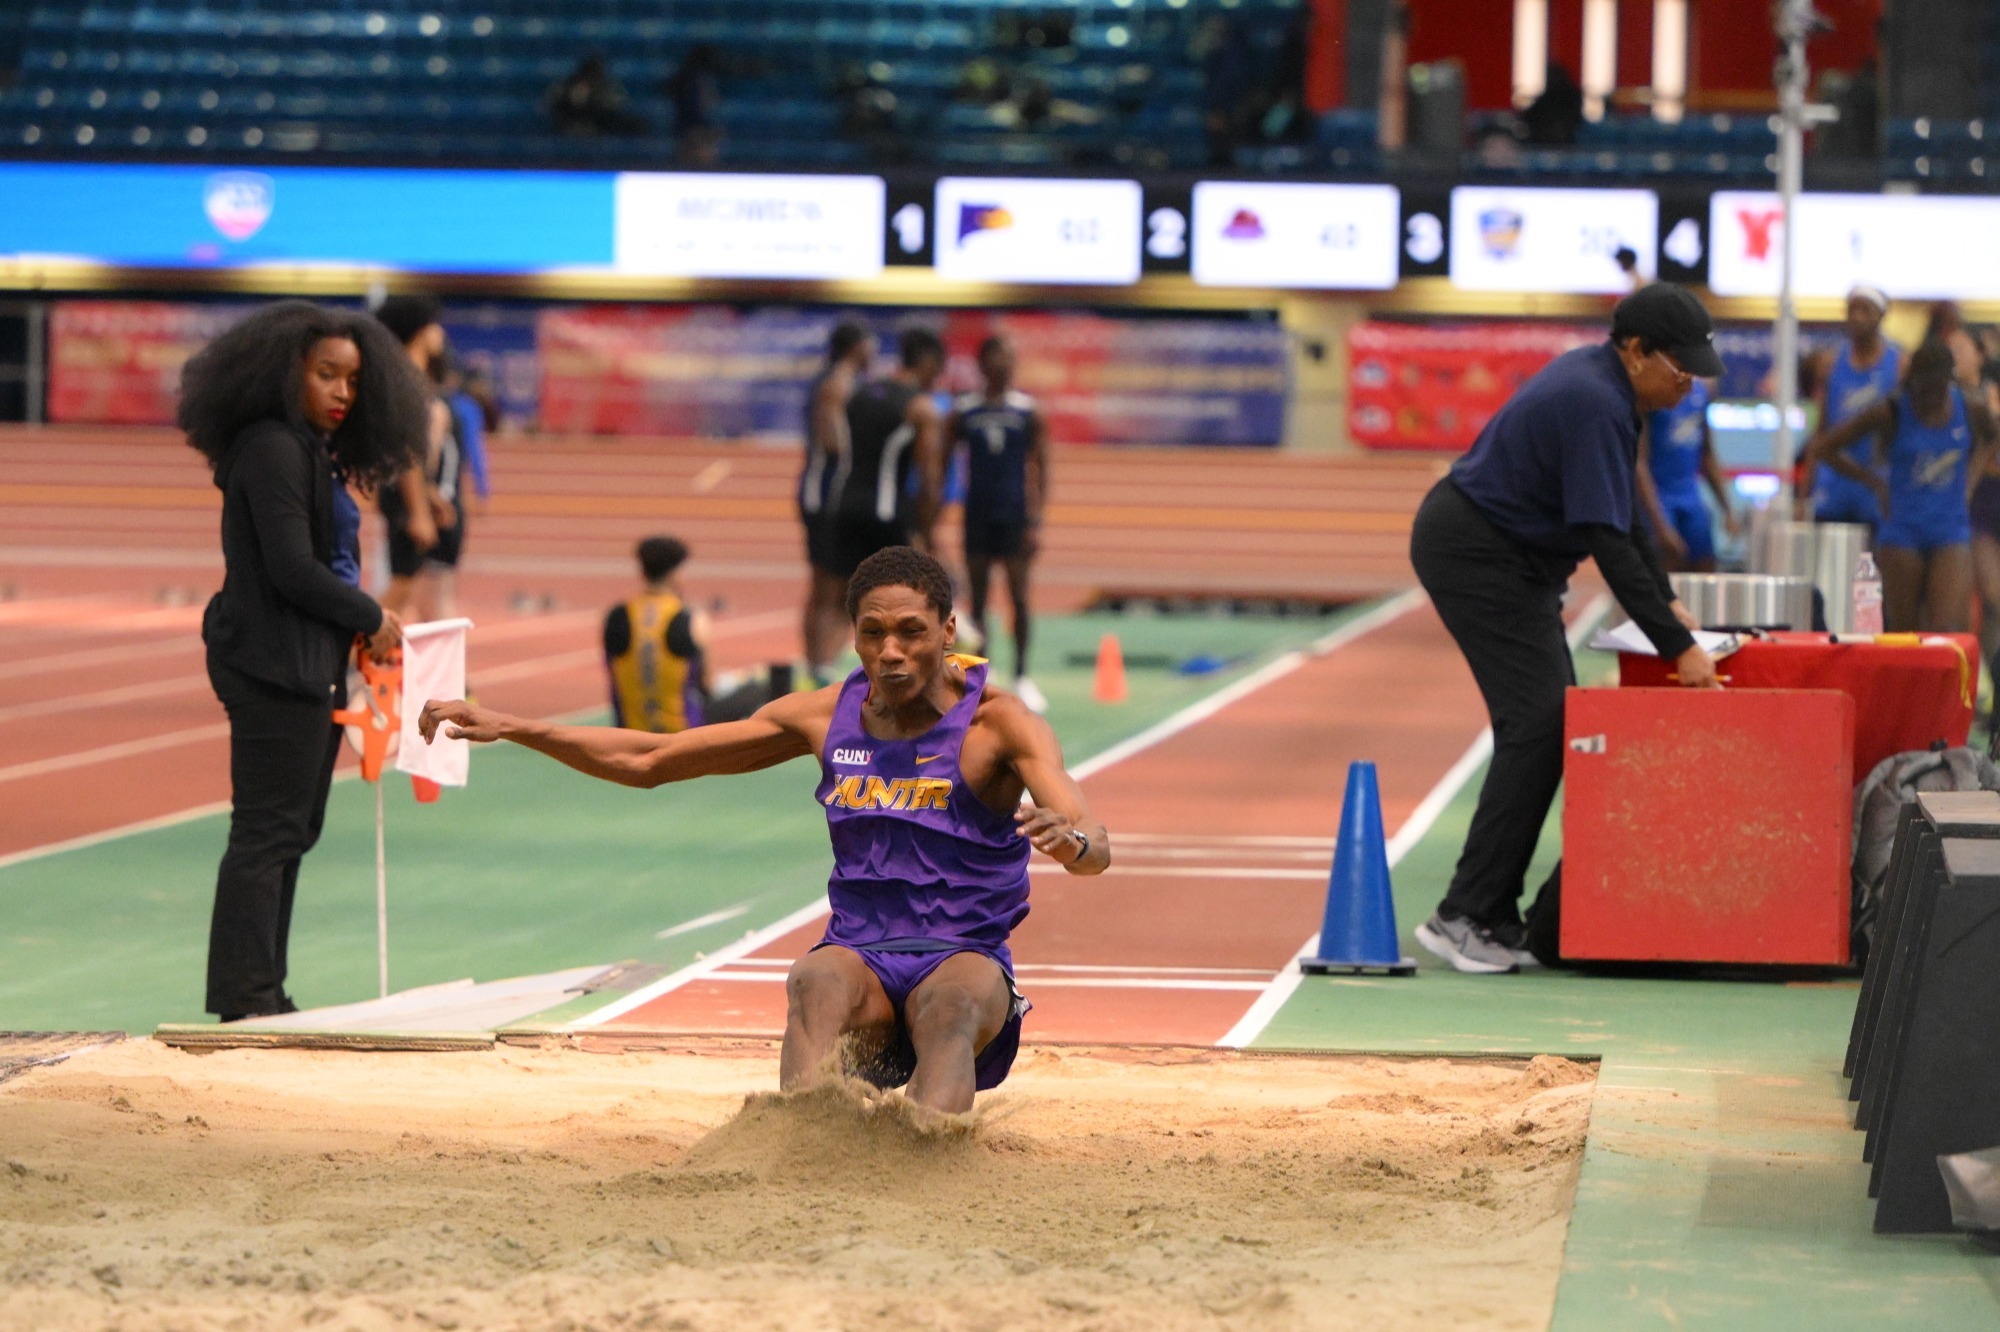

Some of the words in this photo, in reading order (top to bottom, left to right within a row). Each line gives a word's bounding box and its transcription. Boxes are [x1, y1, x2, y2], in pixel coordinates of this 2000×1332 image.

[892, 203, 925, 253] 1
[1147, 207, 1186, 258] 2
[1405, 212, 1444, 264] 3
[1663, 217, 1702, 268] 4
[833, 748, 874, 765] CUNY
[825, 774, 953, 811] HUNTER
